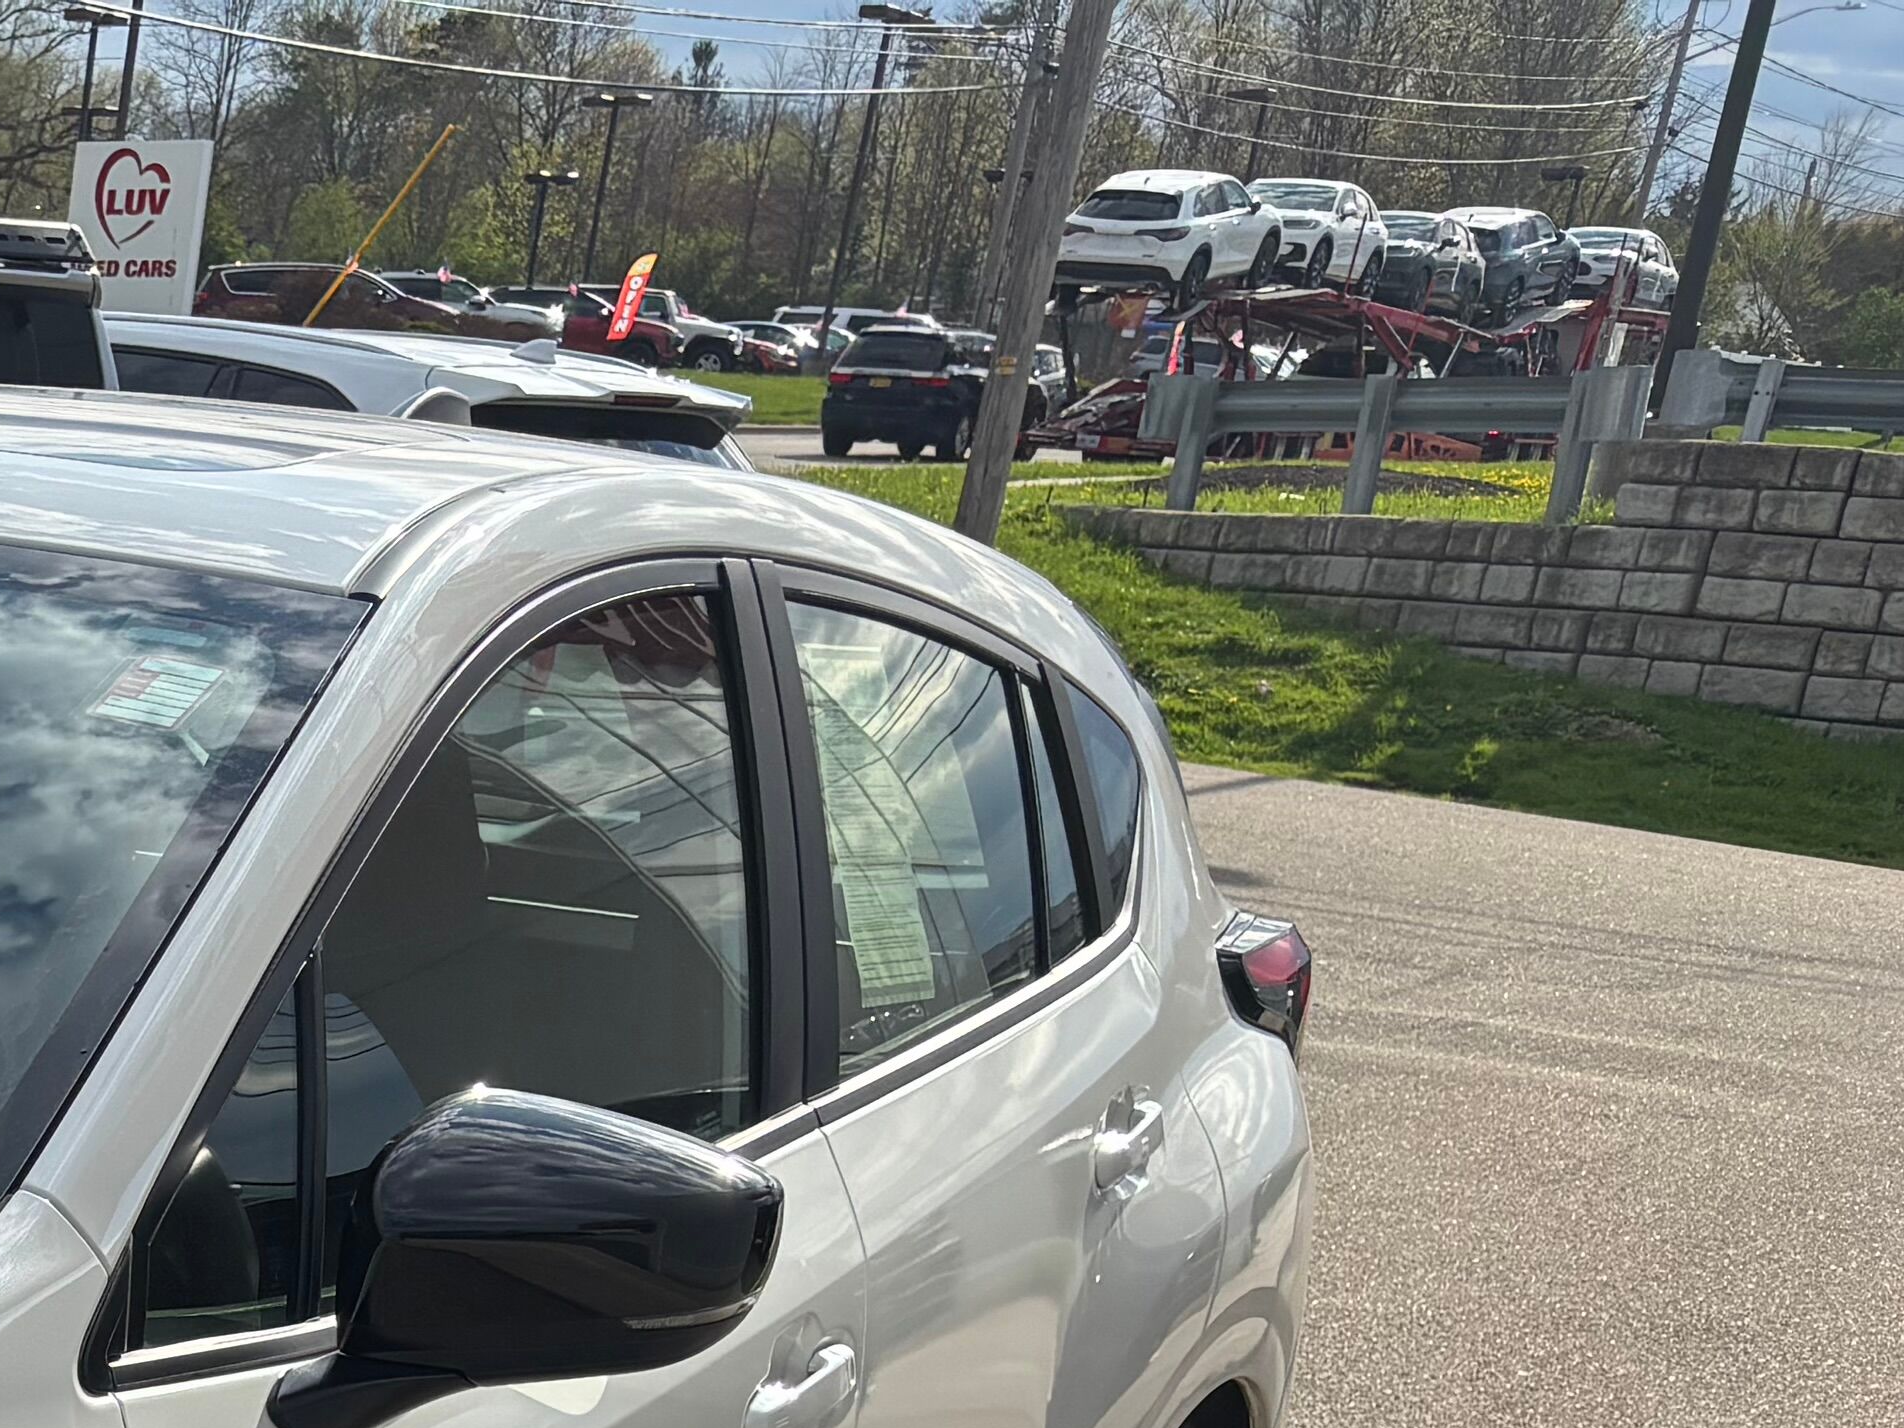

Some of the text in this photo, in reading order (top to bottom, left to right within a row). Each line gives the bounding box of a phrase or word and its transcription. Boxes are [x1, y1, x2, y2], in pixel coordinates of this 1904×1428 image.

[106, 188, 171, 215] LUV
[95, 259, 177, 278] ED CARS
[613, 276, 644, 333] OPEN
